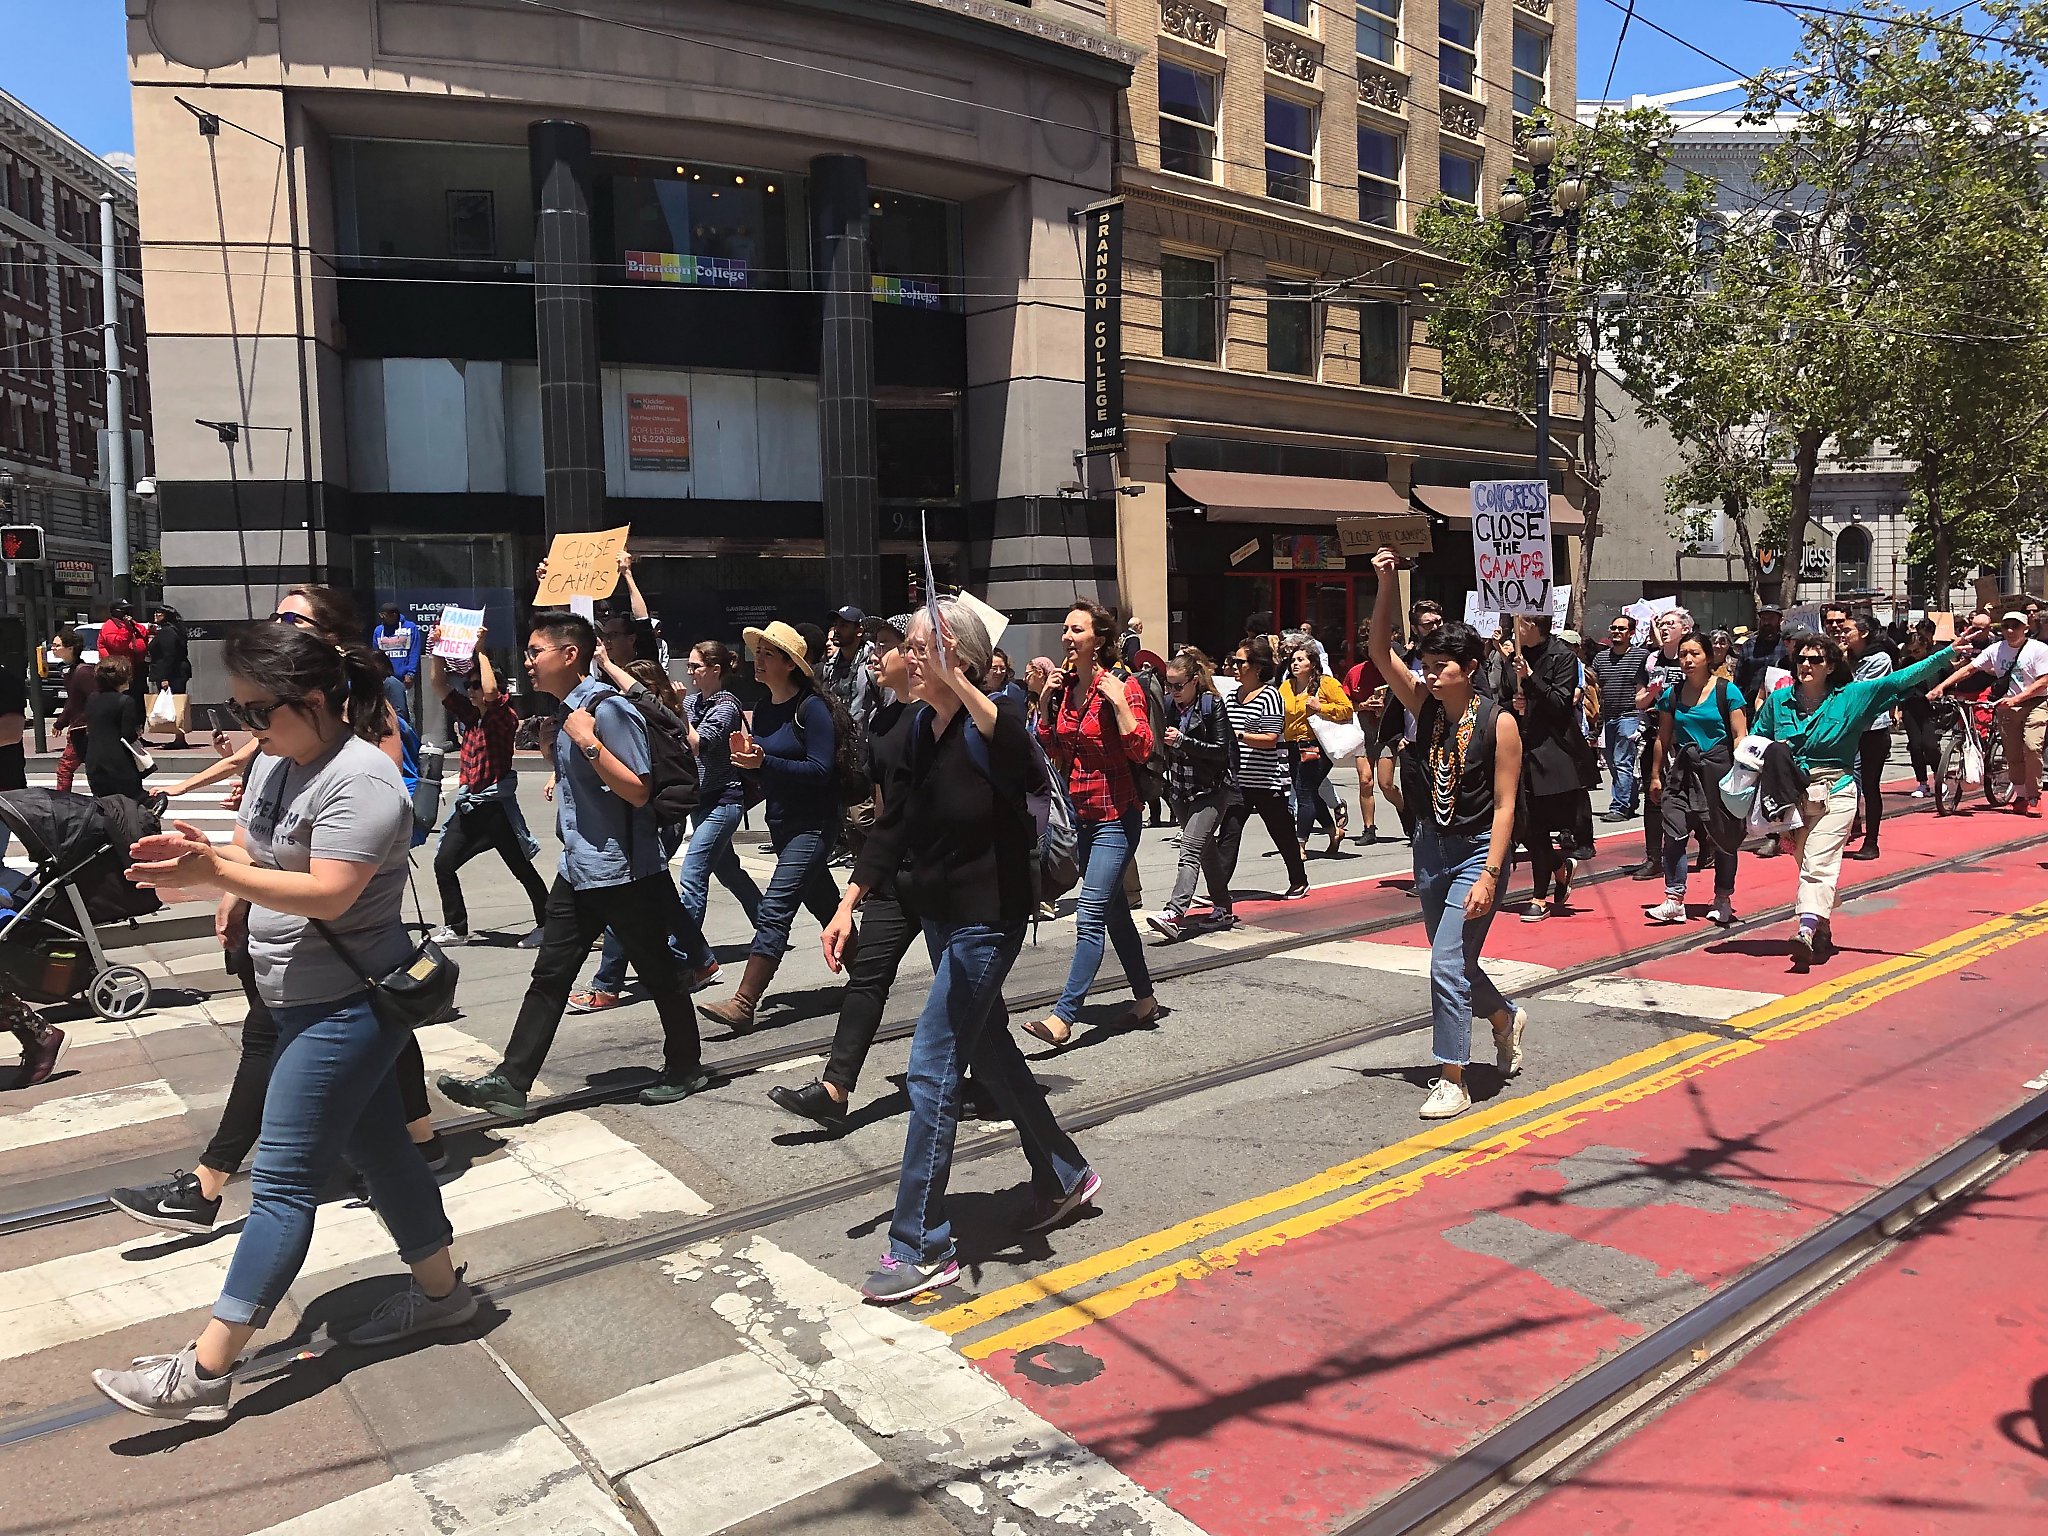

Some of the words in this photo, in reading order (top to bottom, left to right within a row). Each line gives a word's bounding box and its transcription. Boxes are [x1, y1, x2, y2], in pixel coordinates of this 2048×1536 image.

[627, 260, 691, 275] Brandon
[695, 265, 745, 282] College
[1095, 212, 1110, 310] BRANDON
[899, 287, 938, 304] College
[1094, 321, 1108, 421] COLLEGE
[631, 426, 648, 434] FOR
[649, 427, 675, 435] LEASE
[1475, 482, 1546, 512] CONGRESS
[1342, 529, 1374, 543] CLOSE
[1377, 529, 1392, 541] THE
[1394, 528, 1428, 541] CAMPS
[1475, 511, 1546, 542] CLOSE
[563, 538, 615, 560] CLOSE
[1492, 541, 1521, 556] THE
[1479, 550, 1545, 582] CAMPS
[547, 570, 609, 593] CAMPS
[440, 624, 473, 640] BELON
[438, 639, 476, 654] TOGETH
